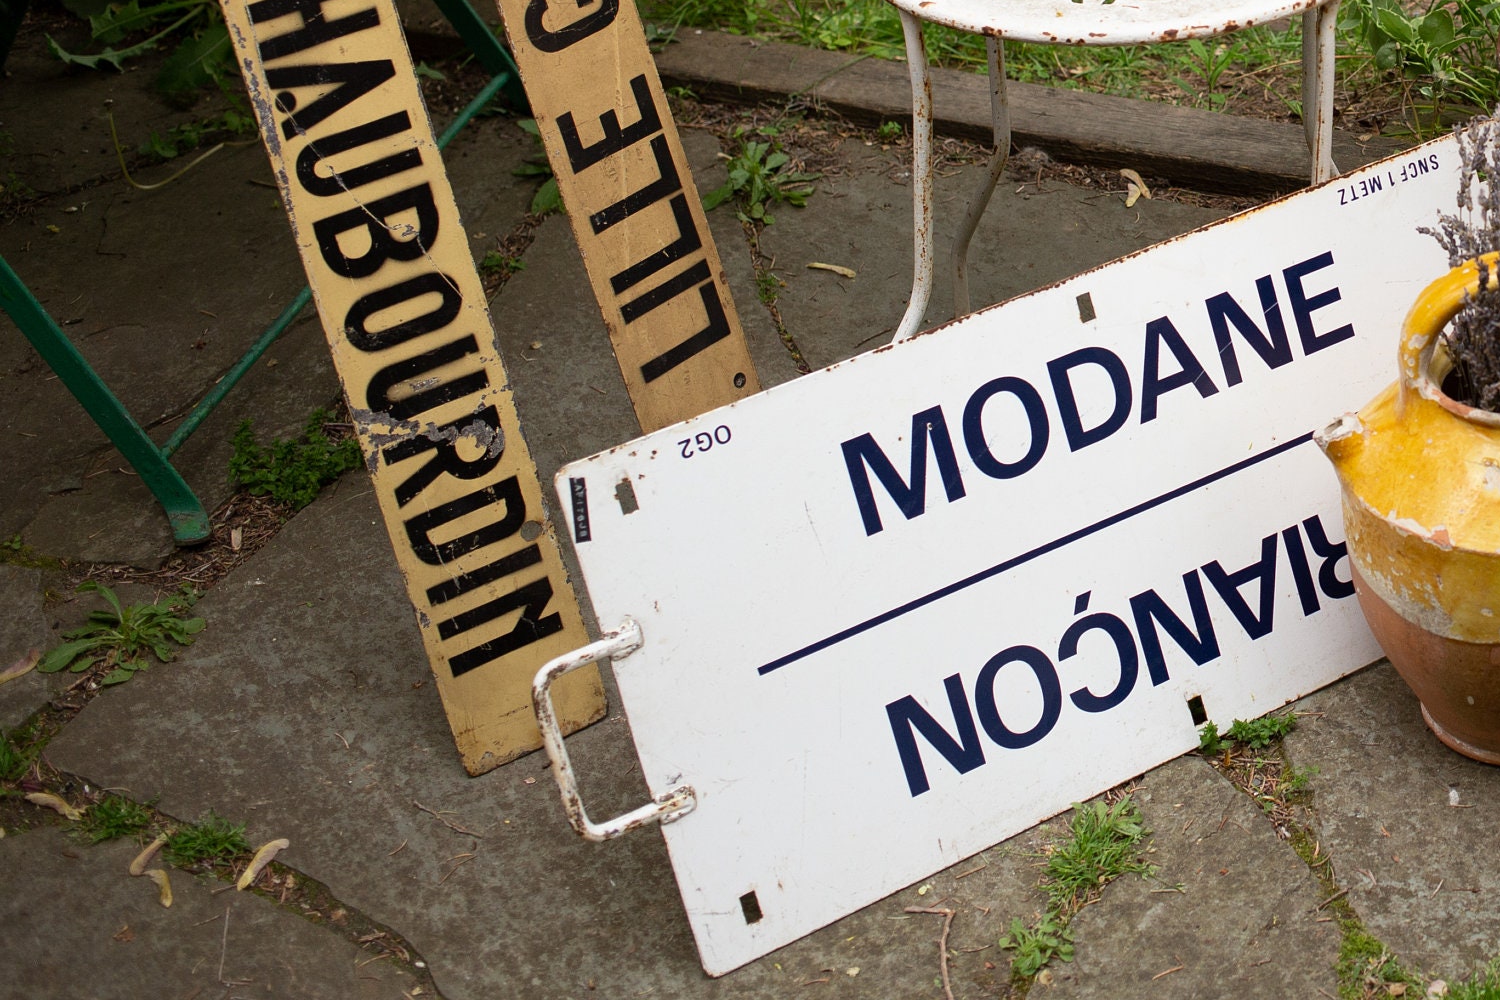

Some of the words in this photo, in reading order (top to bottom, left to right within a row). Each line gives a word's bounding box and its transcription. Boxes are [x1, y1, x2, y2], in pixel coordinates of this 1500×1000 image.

[555, 73, 731, 384] LILLE
[1337, 175, 1383, 206] METZ
[1400, 154, 1440, 183] SNCF
[677, 424, 732, 459] OG2
[840, 250, 1356, 537] MODANE
[885, 514, 1360, 798] RIANÇON
